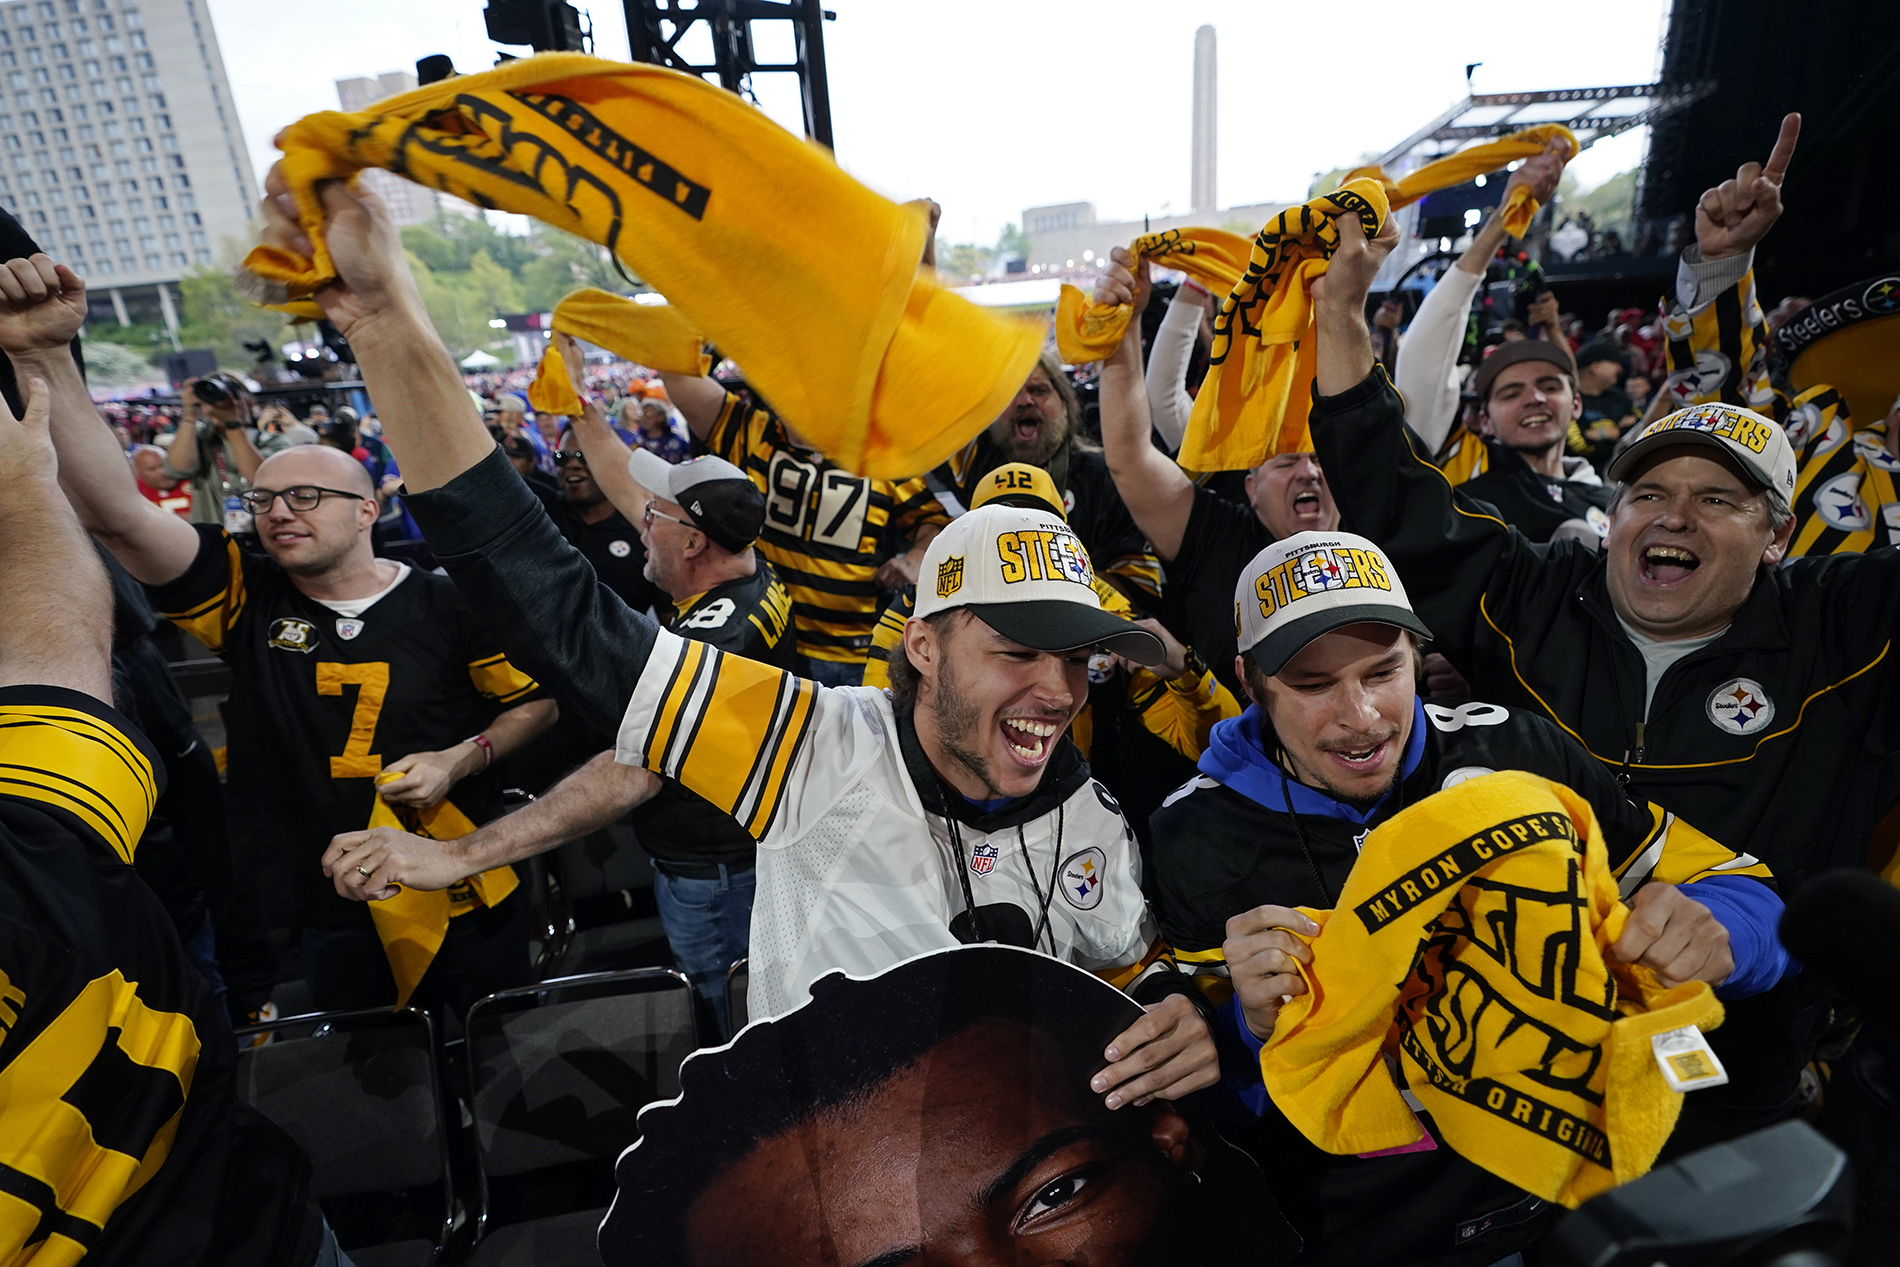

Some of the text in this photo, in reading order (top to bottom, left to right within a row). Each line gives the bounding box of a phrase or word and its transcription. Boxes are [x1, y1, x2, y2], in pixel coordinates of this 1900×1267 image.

[1777, 298, 1863, 351] Steelers
[767, 454, 868, 546] 97
[1038, 522, 1074, 533] PITTSB
[1284, 541, 1342, 559] PITTSBURGH
[937, 571, 960, 593] NFL
[1254, 547, 1393, 620] STEELERS
[683, 597, 737, 629] 8
[315, 661, 390, 779] 7
[972, 856, 993, 873] NFL
[1066, 869, 1084, 881] Steelers
[1367, 853, 1462, 923] MYRON
[1471, 814, 1566, 861] COPE'S
[1486, 1085, 1605, 1161] ORIGIL
